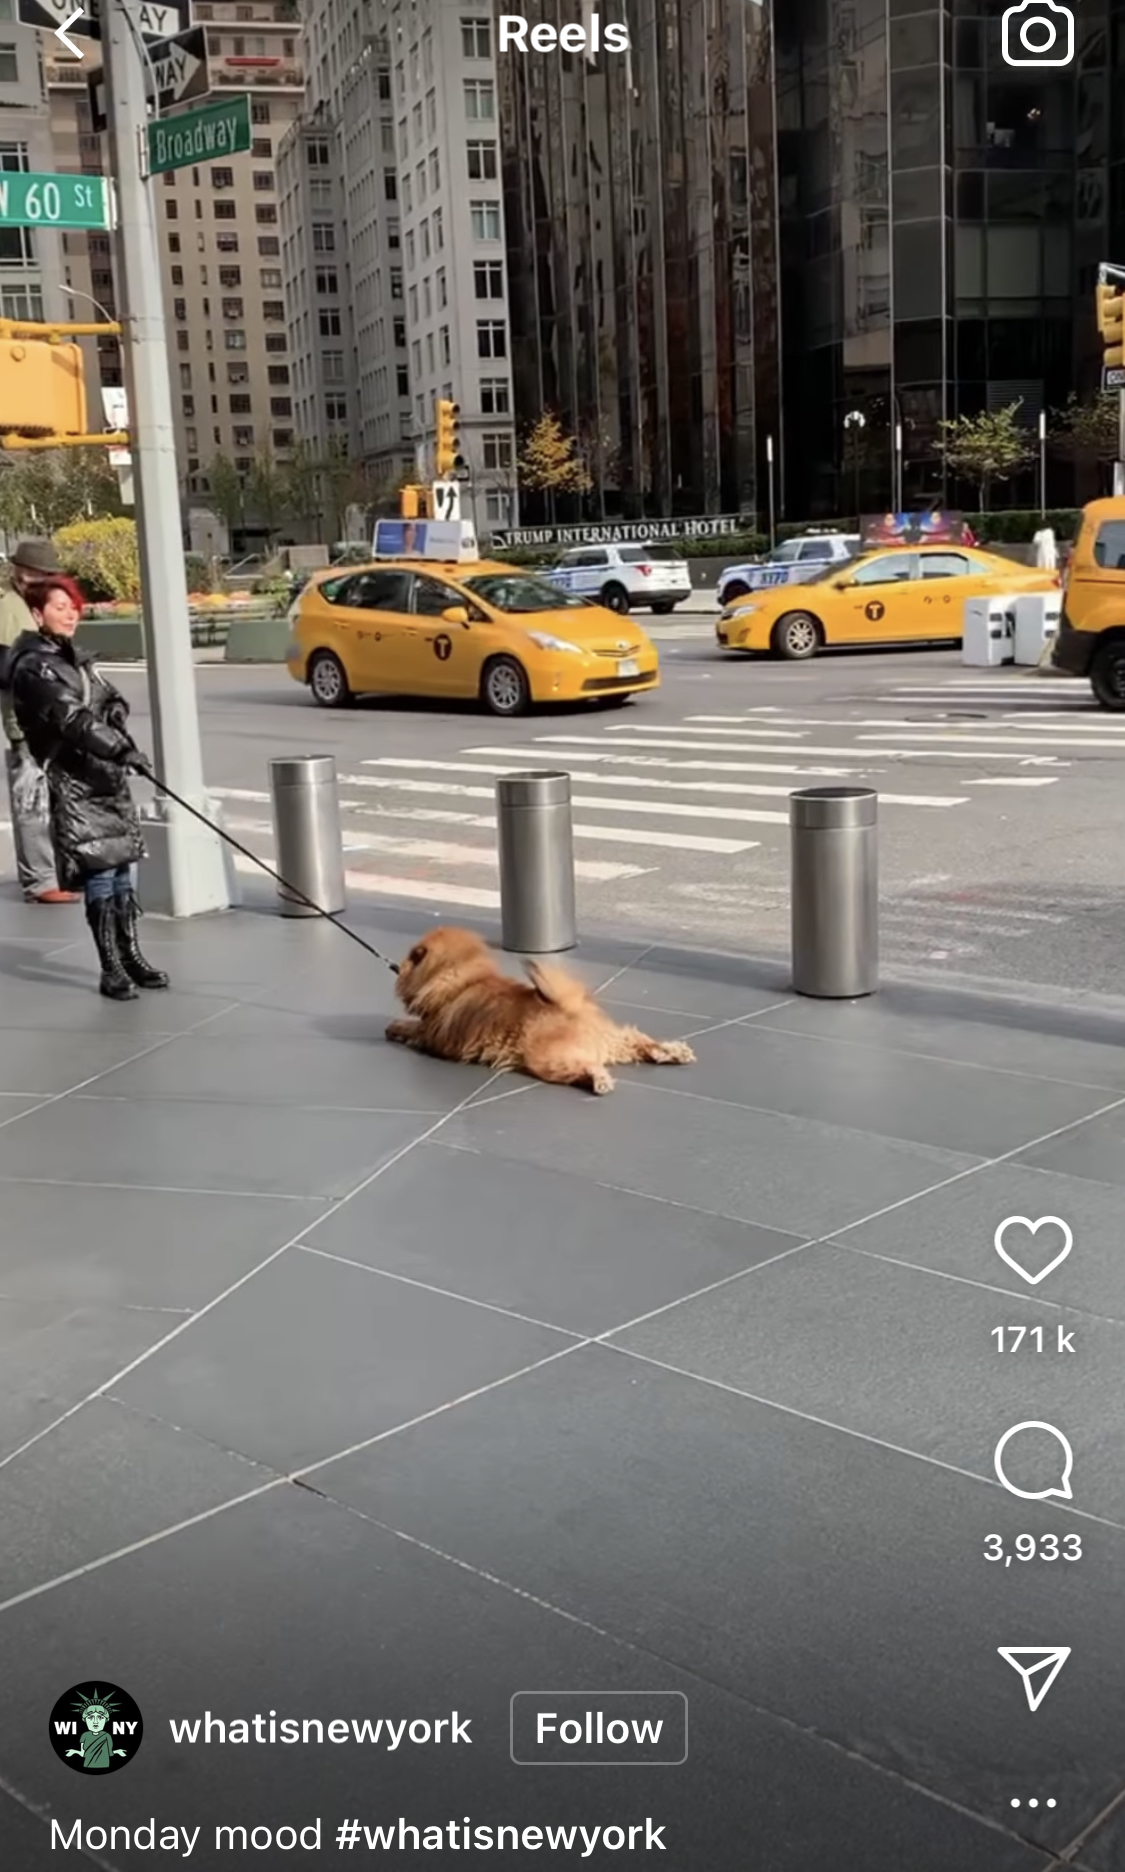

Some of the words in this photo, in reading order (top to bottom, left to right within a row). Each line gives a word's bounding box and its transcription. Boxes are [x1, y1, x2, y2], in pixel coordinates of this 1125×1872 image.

[156, 117, 237, 165] Broadway
[25, 182, 61, 221] 60
[74, 183, 93, 208] St
[505, 529, 553, 546] TRUMP
[557, 522, 681, 543] INTERNATIONAL
[684, 519, 741, 537] HOTEL
